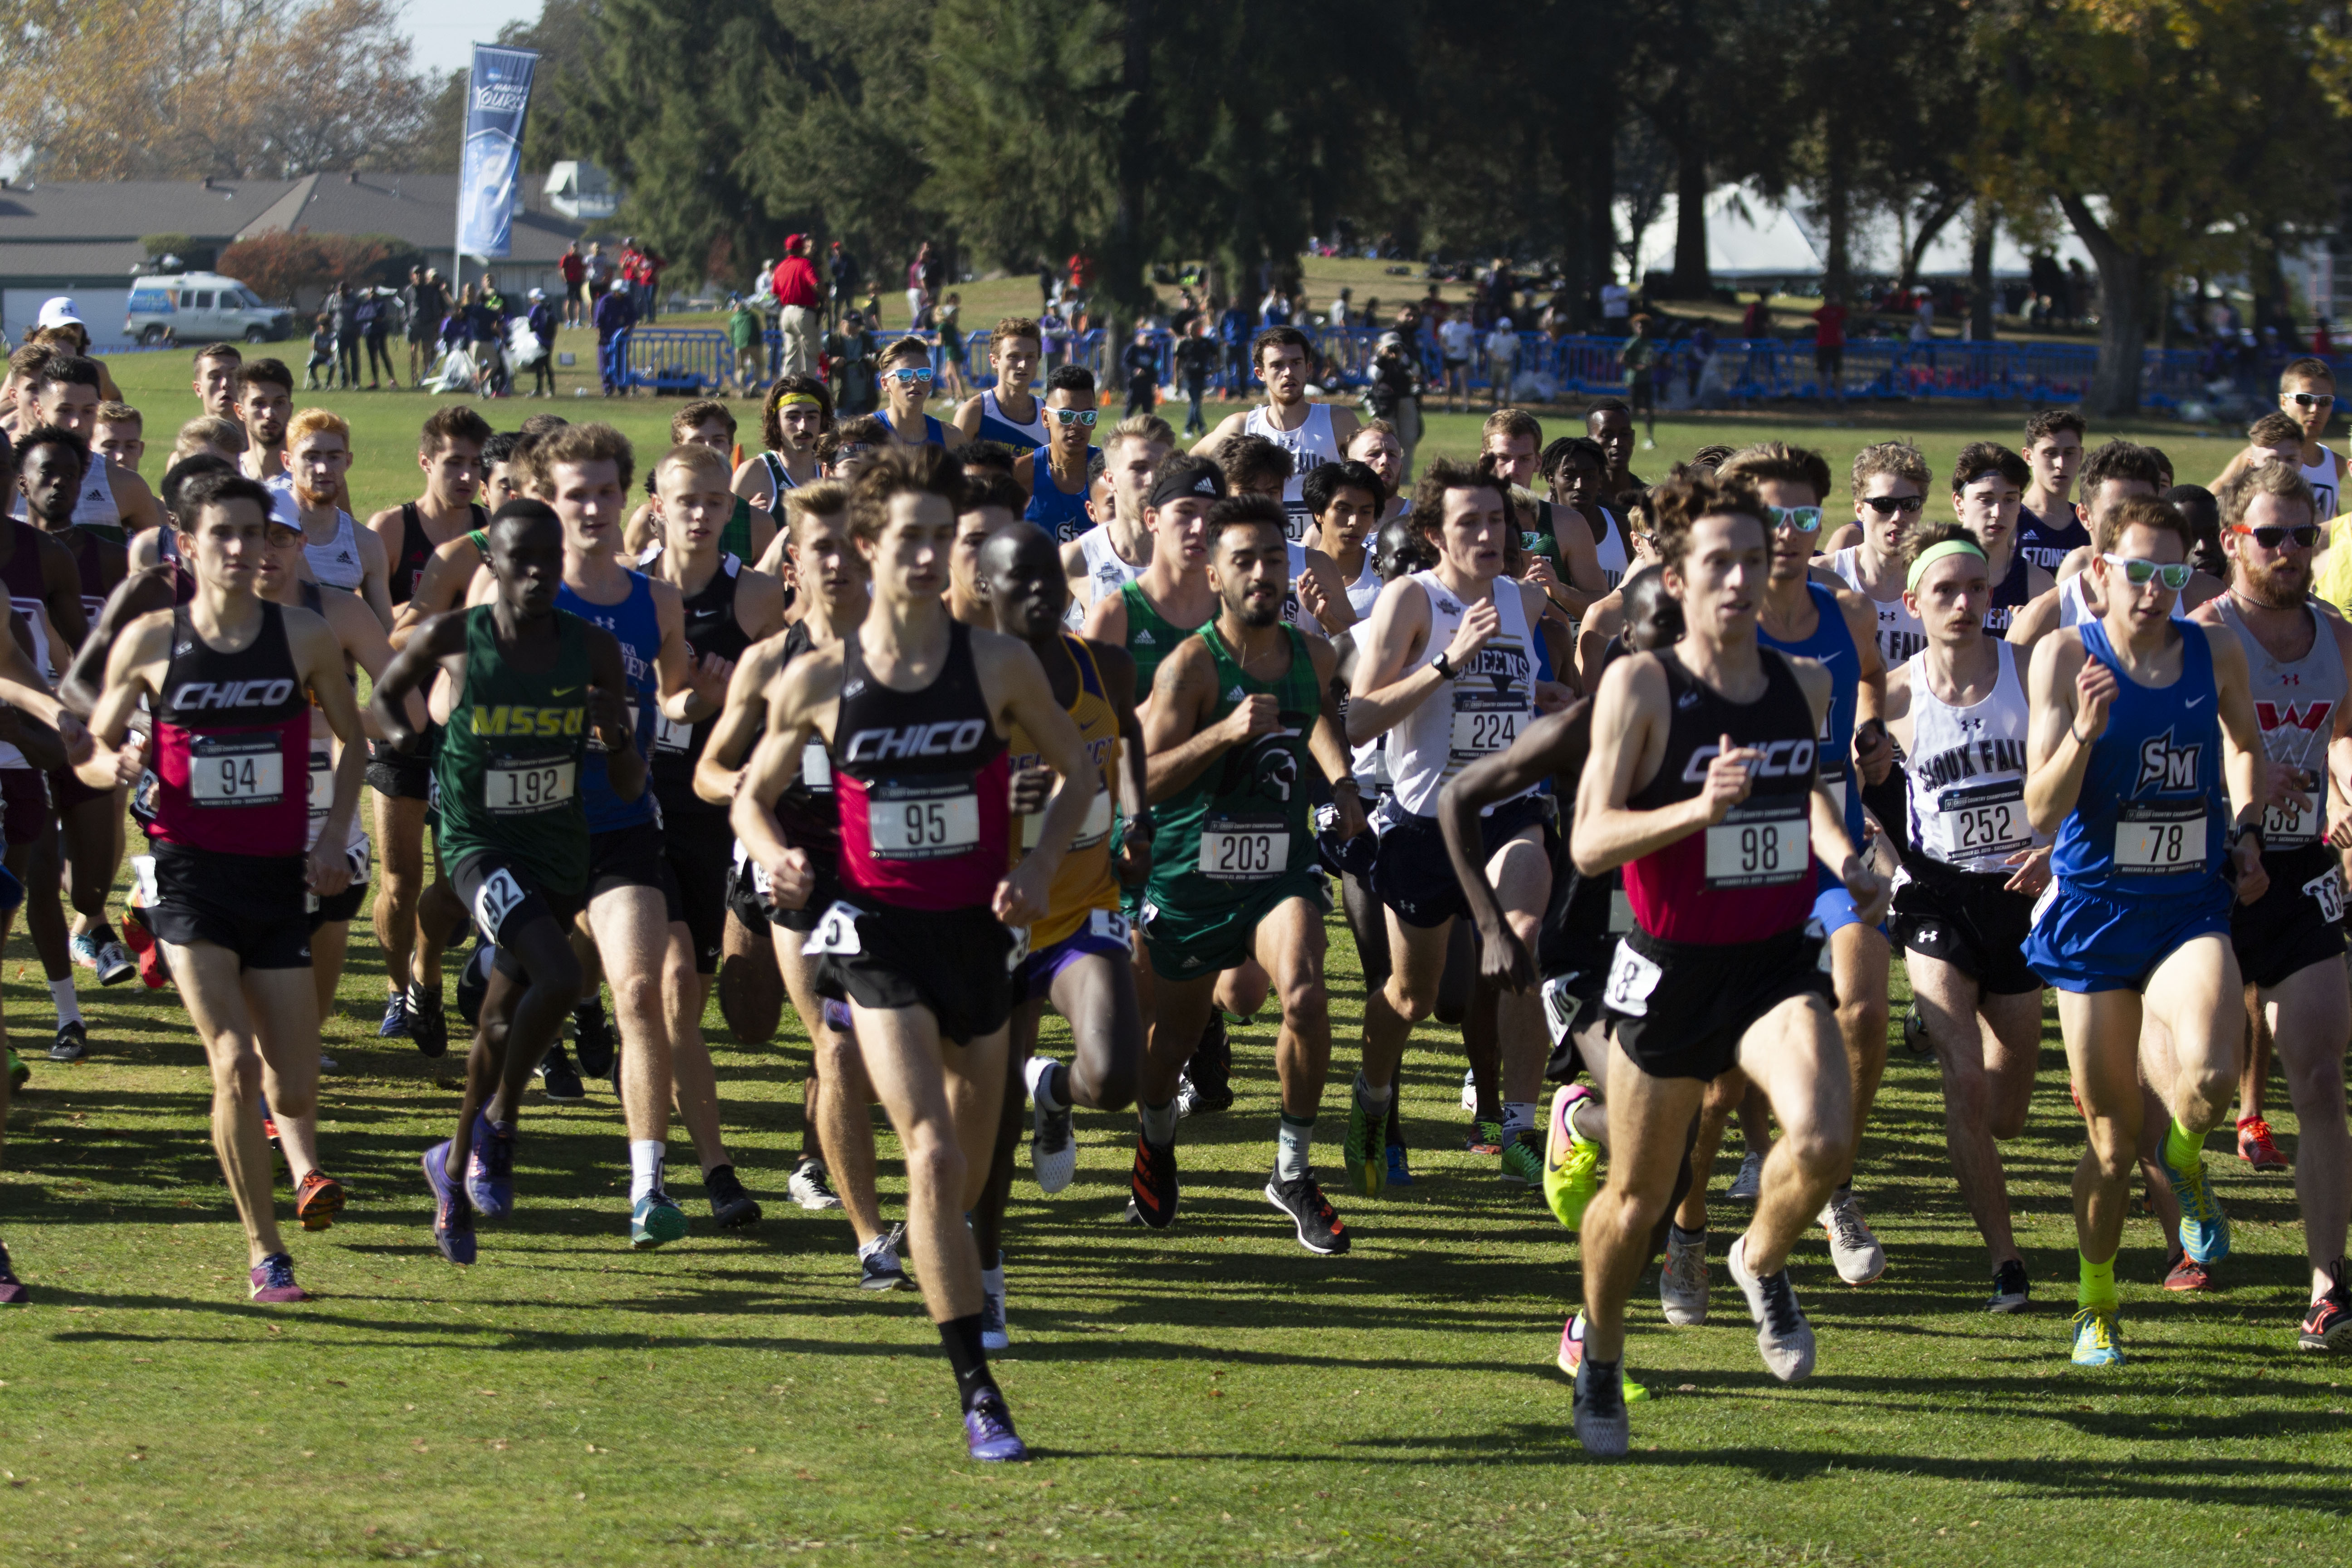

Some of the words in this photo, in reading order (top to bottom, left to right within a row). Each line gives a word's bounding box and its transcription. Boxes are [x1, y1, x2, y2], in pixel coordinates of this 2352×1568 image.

[173, 679, 294, 710] CHICO
[472, 705, 584, 737] MSSU
[1472, 714, 1515, 748] 224
[847, 718, 986, 764] CHICO
[222, 758, 258, 795] 94
[1683, 739, 1815, 783] CICO
[1918, 743, 1976, 792] SIOUX
[508, 769, 559, 805] 192
[1986, 790, 2019, 801] CHAMPIONSHIPS
[906, 803, 946, 845] 95
[1960, 805, 2013, 847] 252
[1220, 835, 1270, 871] 203
[1742, 825, 1779, 871] 98
[1994, 843, 2021, 851] SACRAMENTO,
[2149, 824, 2183, 862] 78
